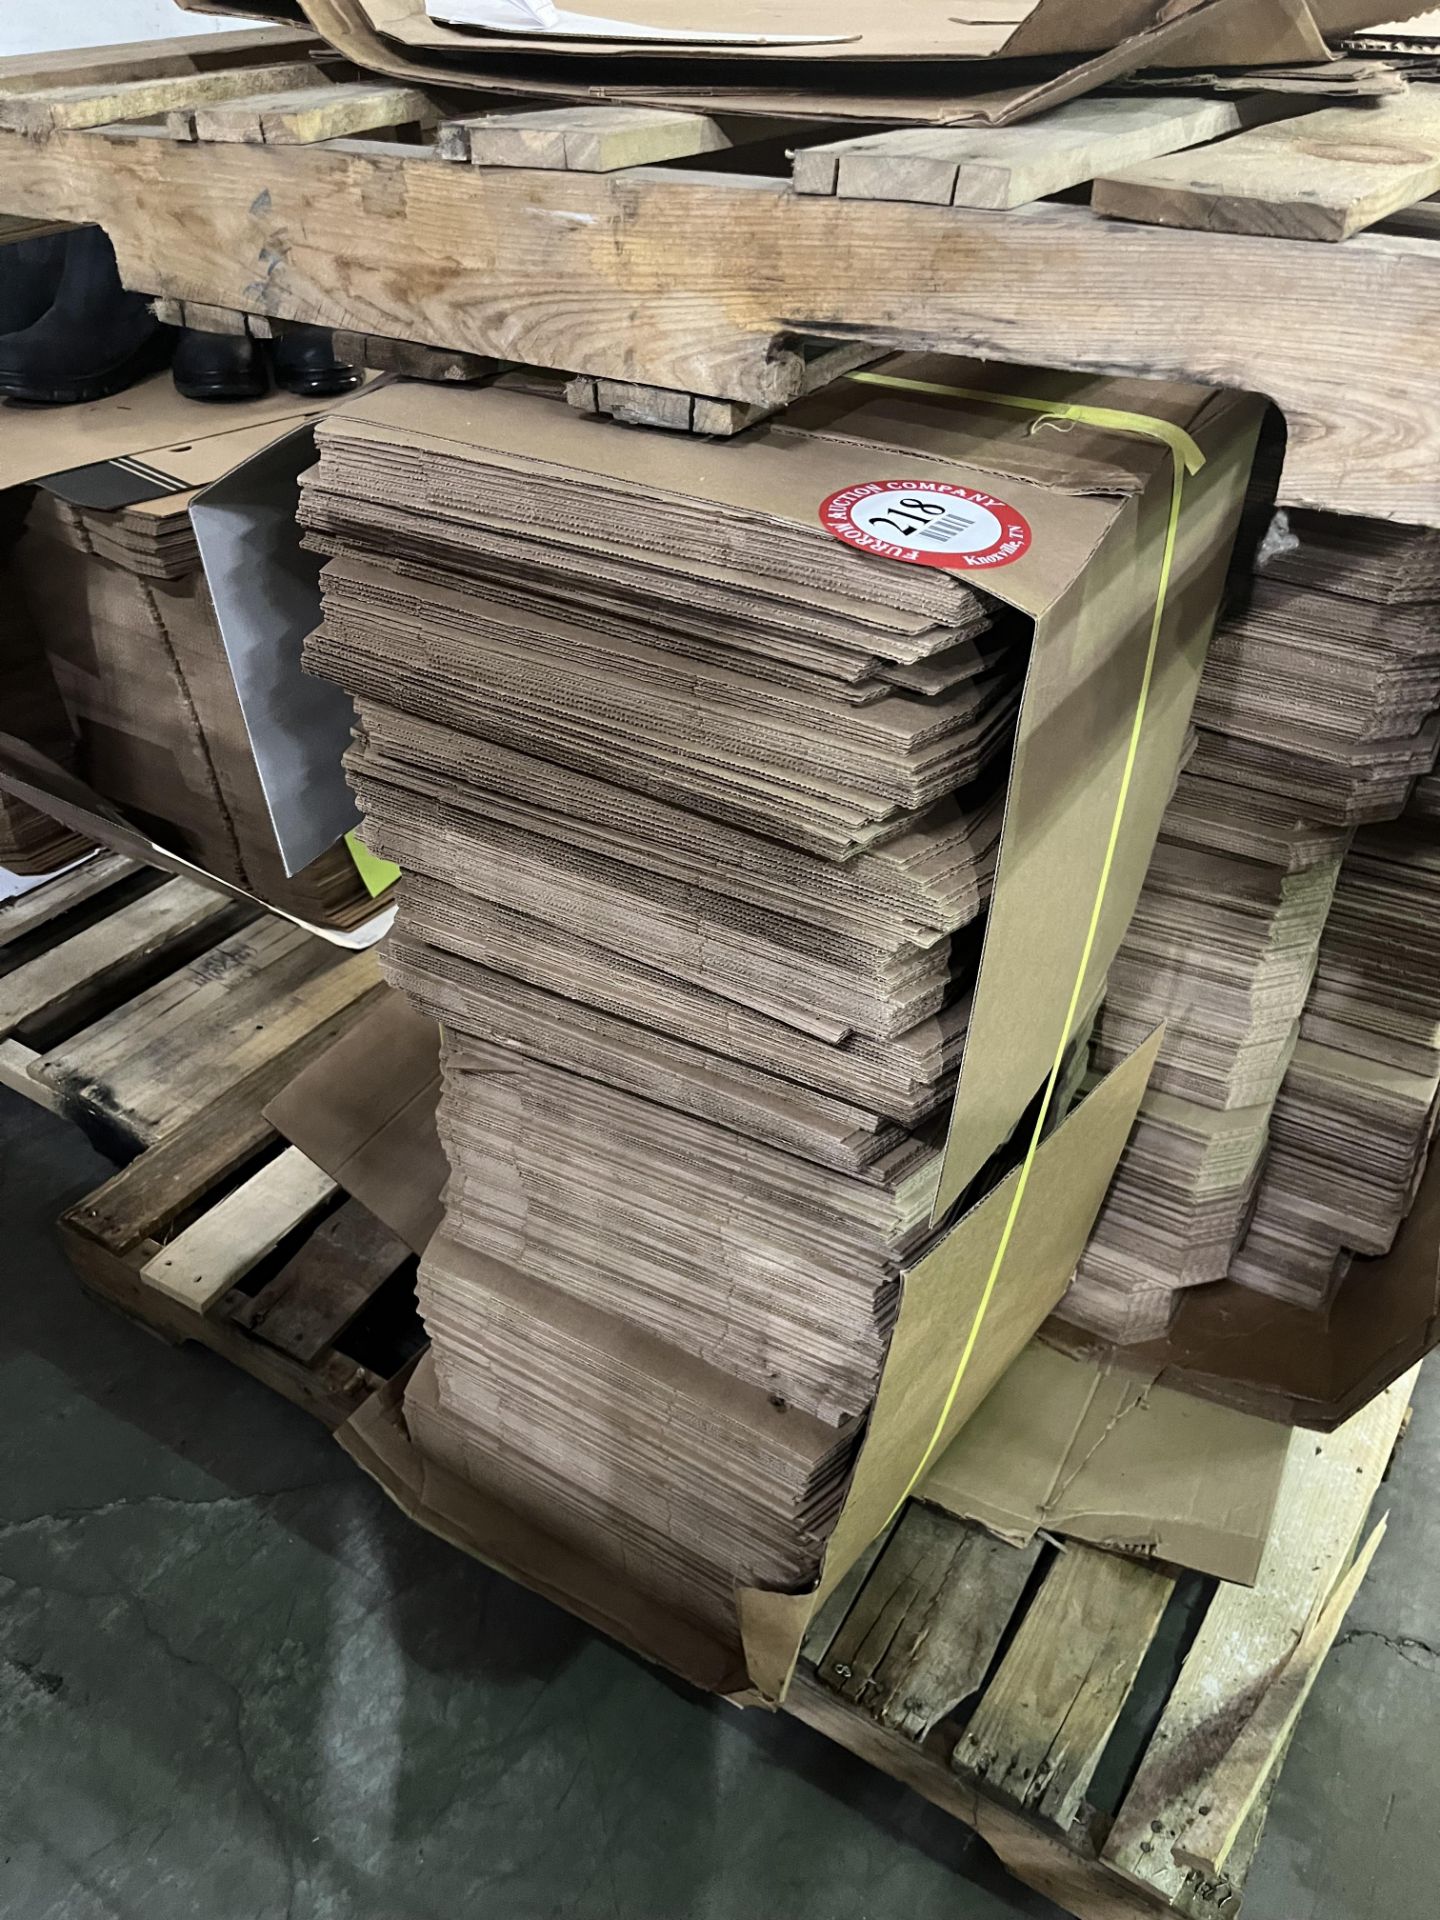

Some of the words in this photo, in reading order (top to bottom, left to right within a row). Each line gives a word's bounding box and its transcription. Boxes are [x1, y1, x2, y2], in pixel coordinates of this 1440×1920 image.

[828, 484, 883, 520] AUCTION
[887, 482, 1005, 507] COMPANY
[869, 498, 945, 536] 218
[828, 523, 919, 560] FURROW
[963, 539, 1025, 566] Knoxville,
[1008, 524, 1024, 538] TN
